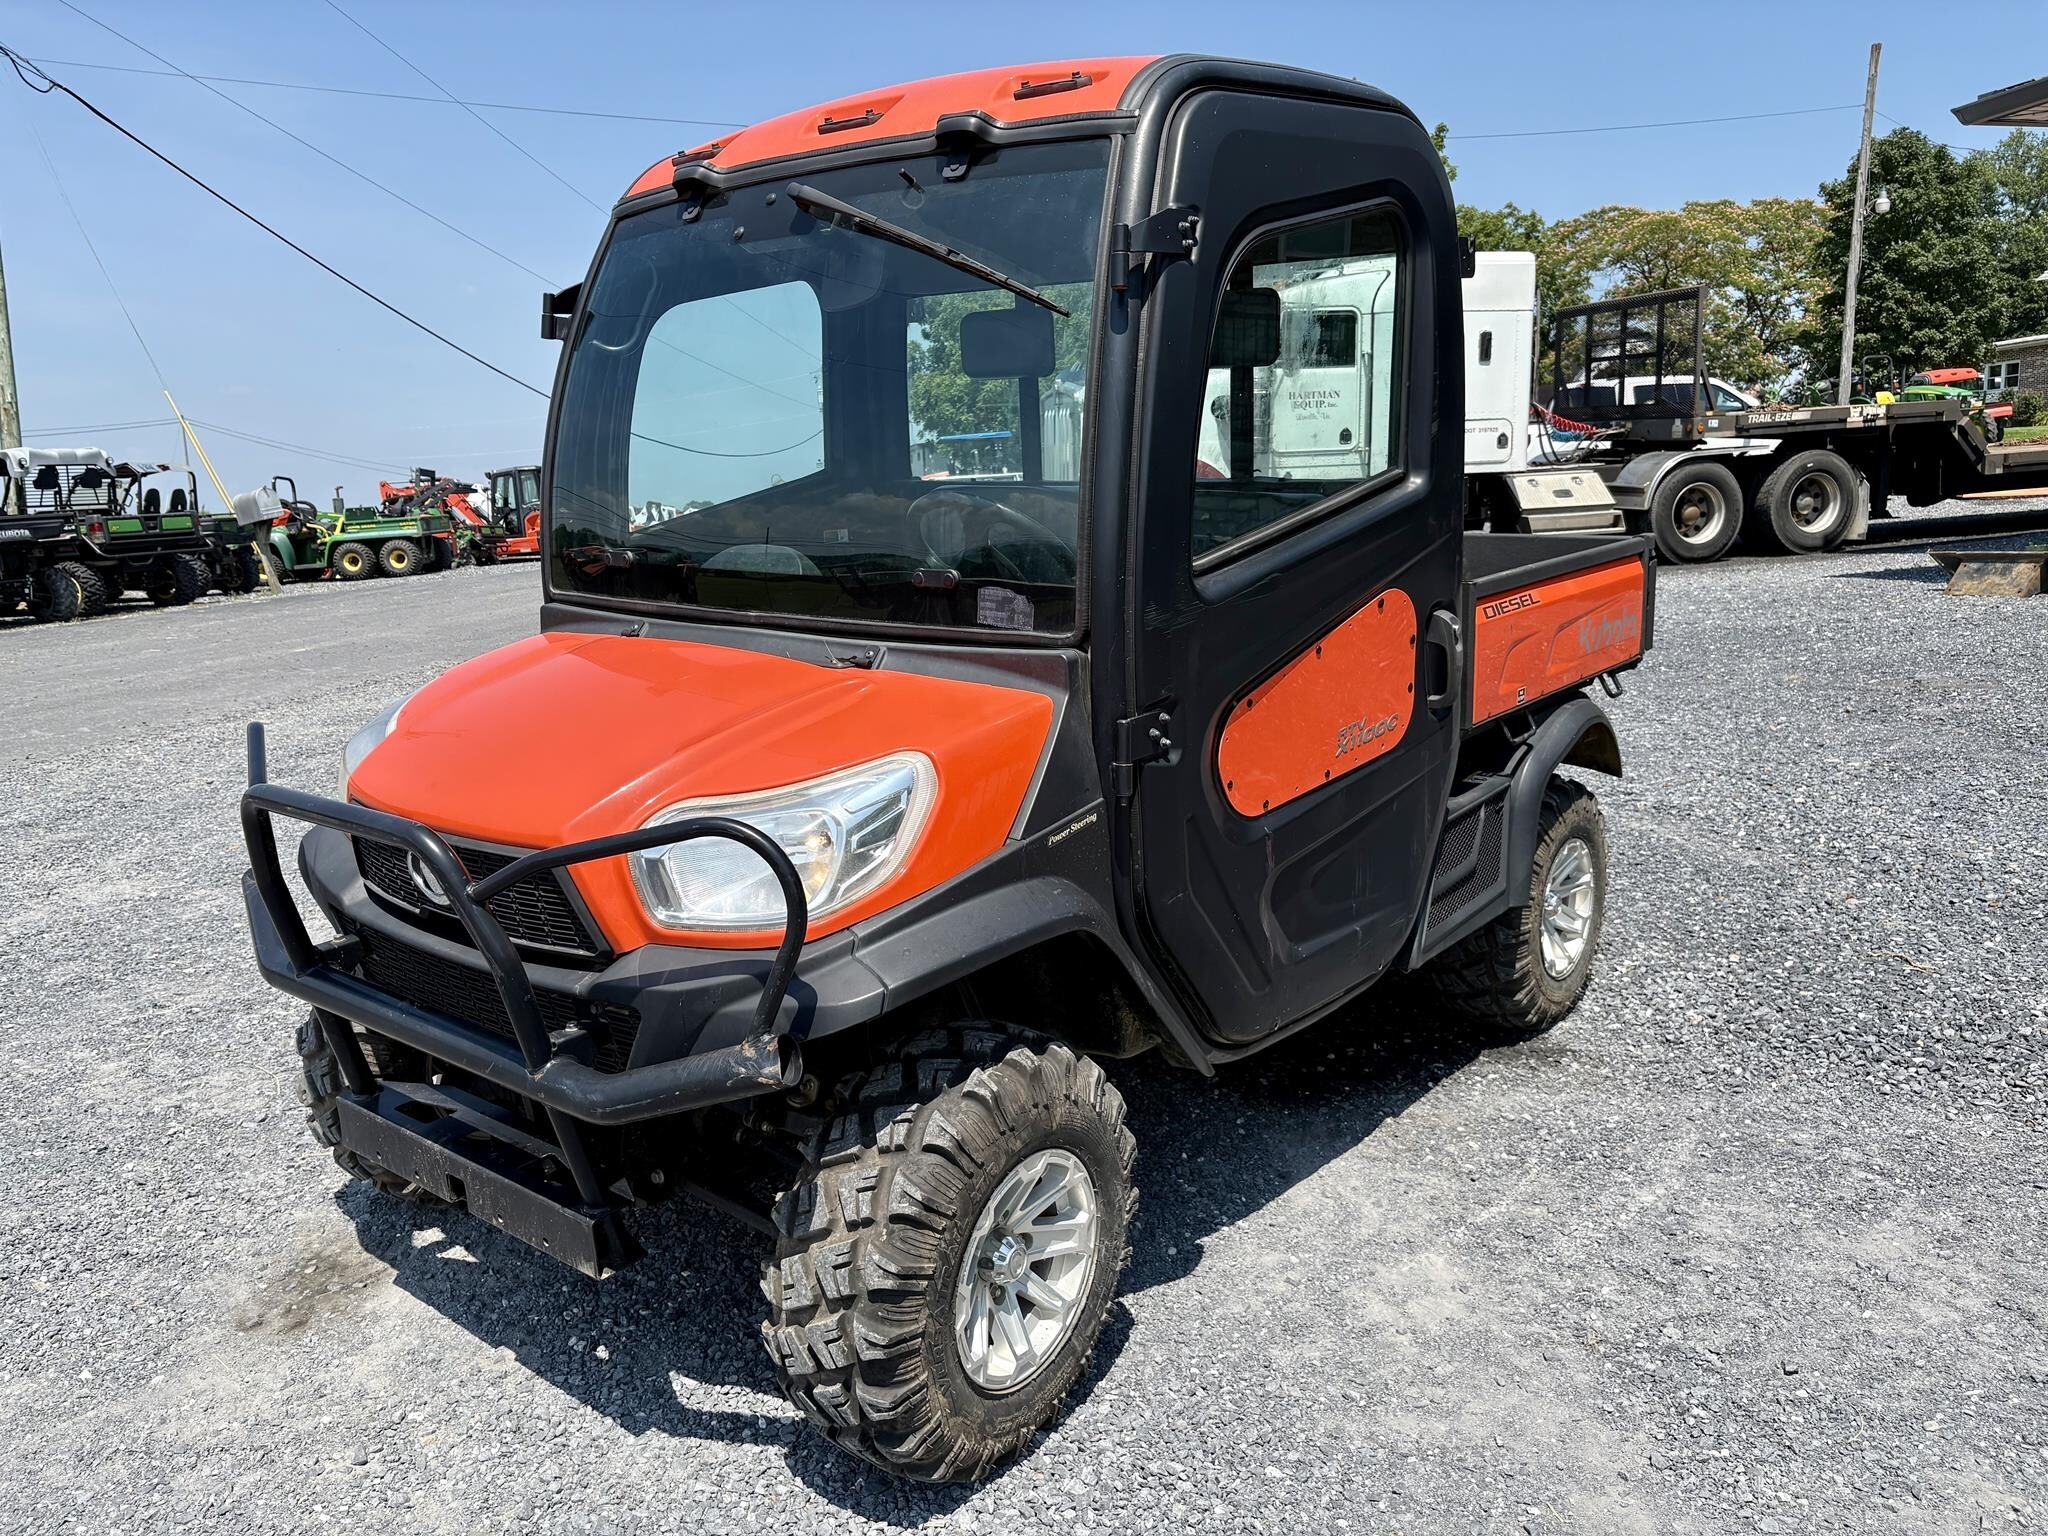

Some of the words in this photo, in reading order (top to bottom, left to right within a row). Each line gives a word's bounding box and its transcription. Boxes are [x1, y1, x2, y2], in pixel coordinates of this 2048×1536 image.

[1289, 390, 1341, 400] HARTMAN
[1483, 593, 1540, 619] DIESEL
[1579, 608, 1637, 654] Kubota
[1338, 716, 1368, 743] RTV
[1048, 828, 1071, 846] Power
[1070, 812, 1097, 833] Steering
